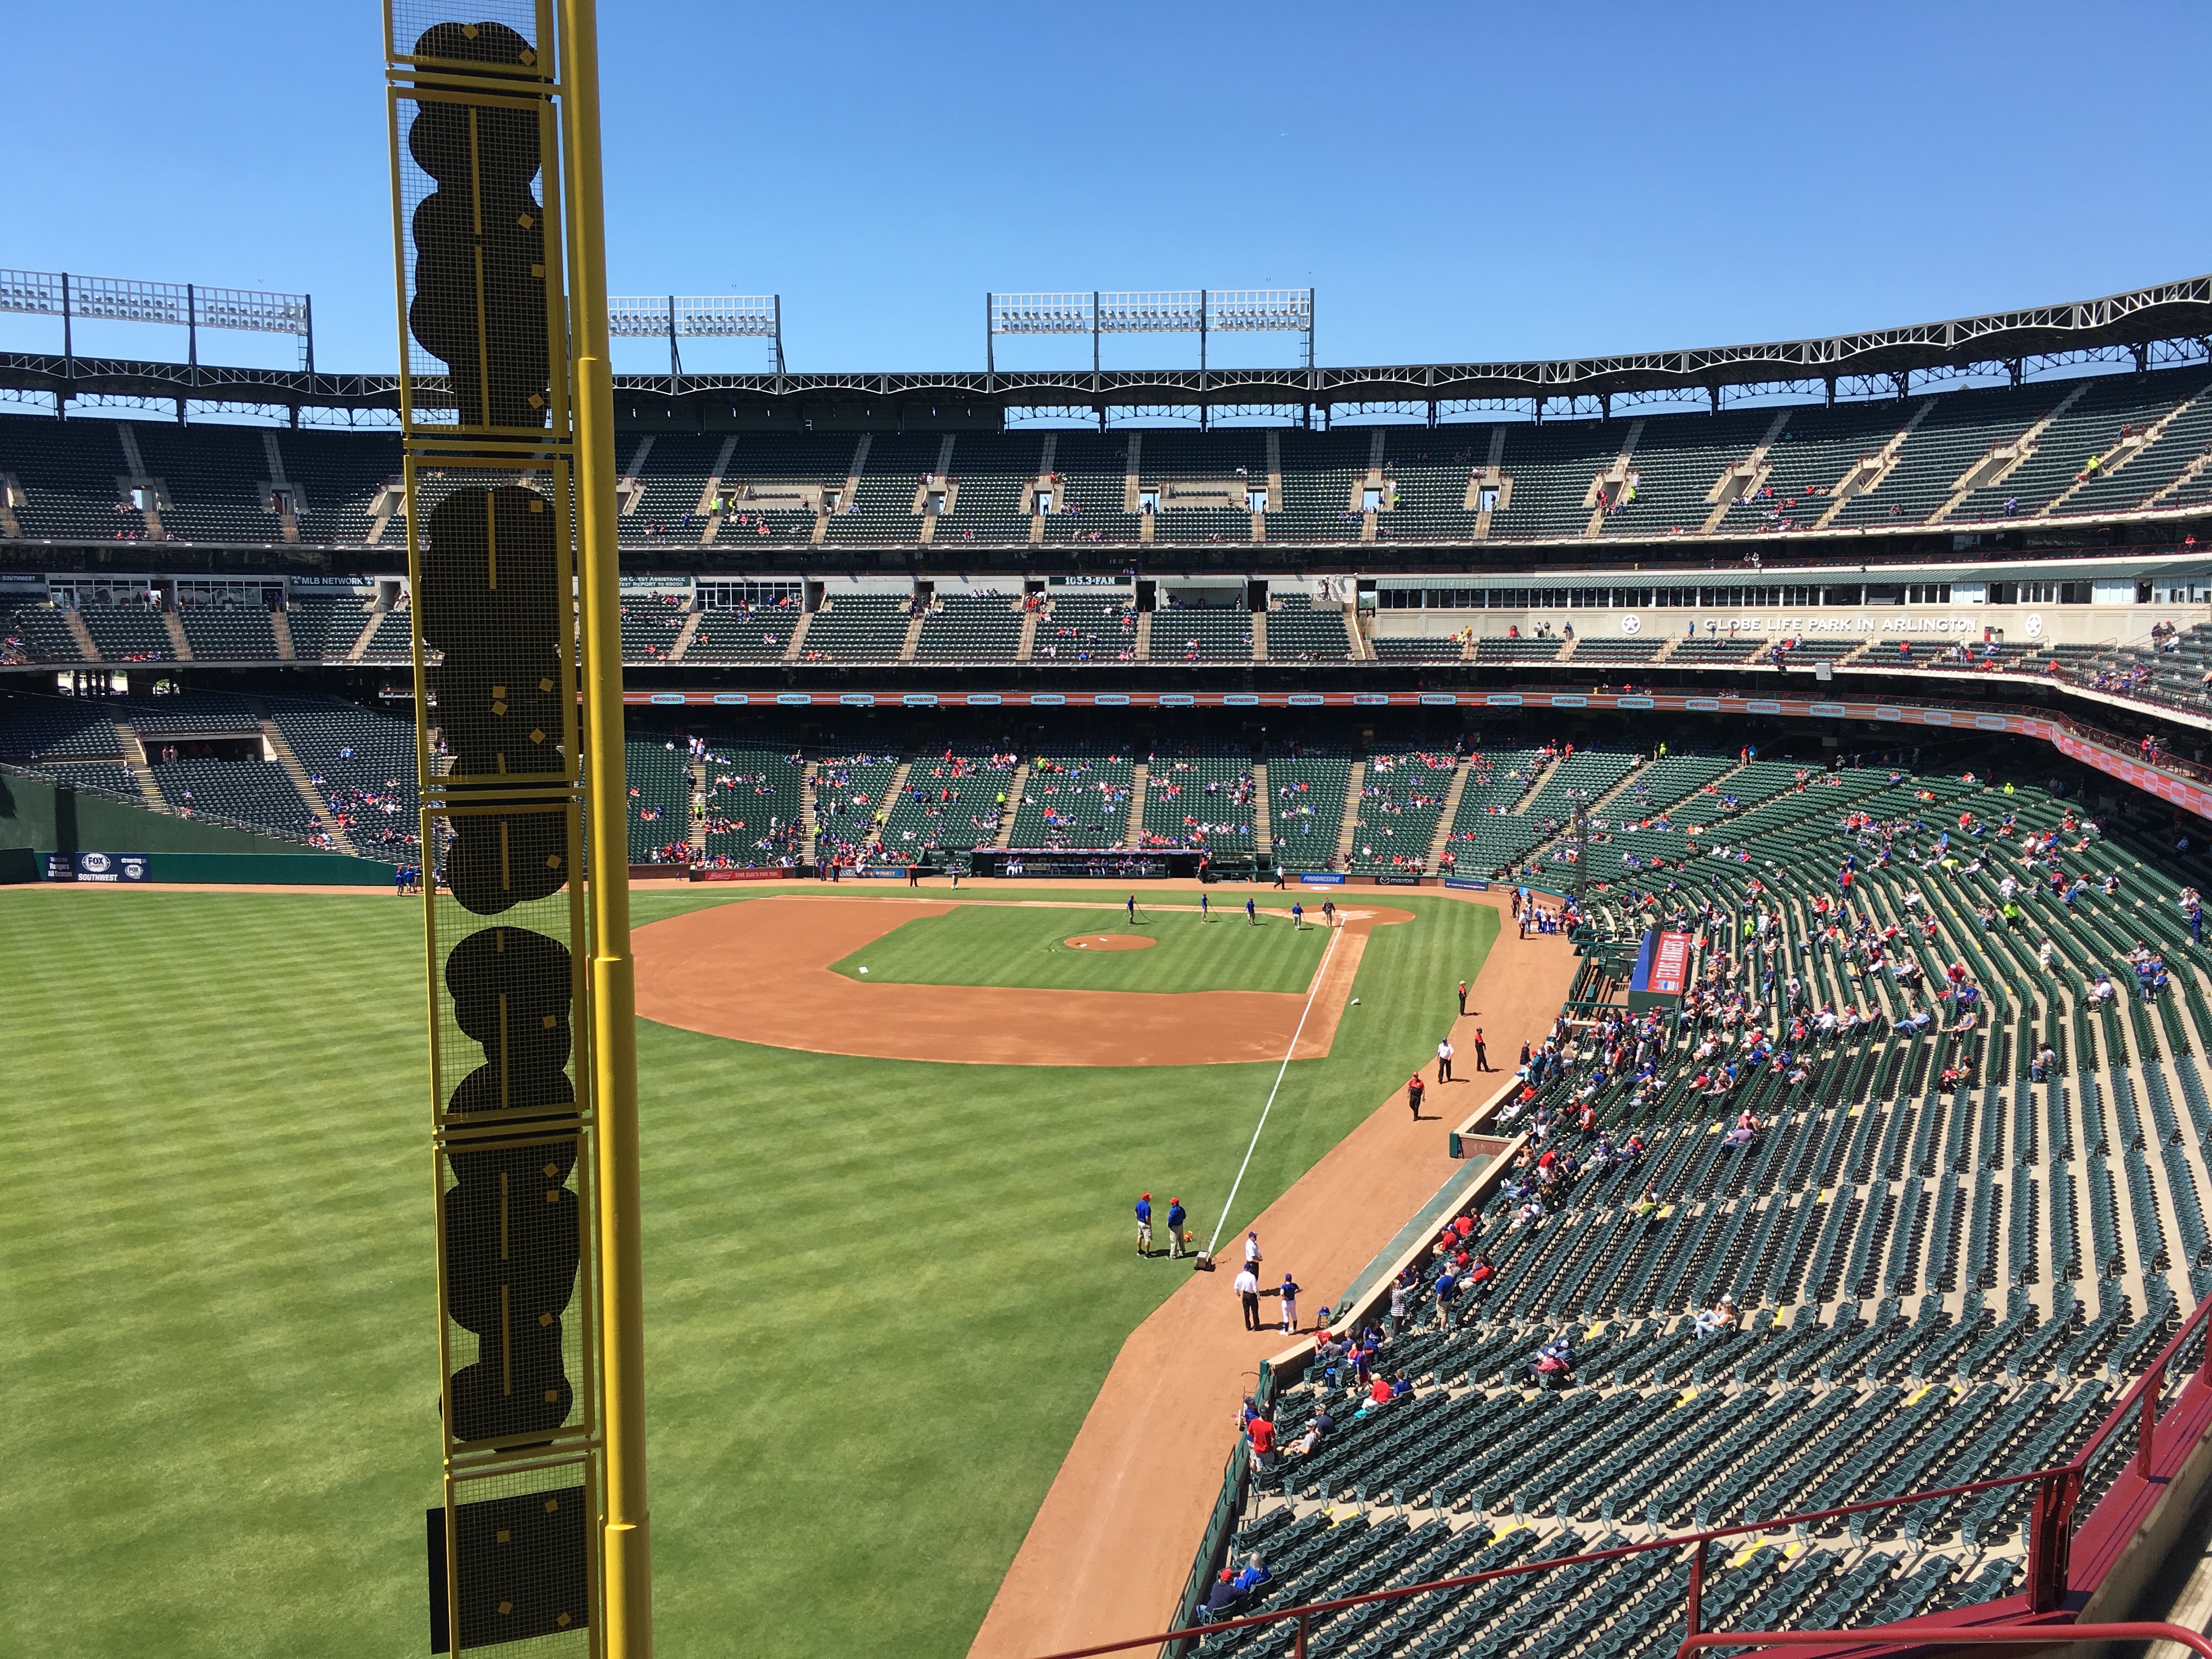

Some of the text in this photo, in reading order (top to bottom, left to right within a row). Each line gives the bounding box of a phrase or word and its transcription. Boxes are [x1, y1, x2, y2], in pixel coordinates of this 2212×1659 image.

[1065, 577, 1092, 585] 105.3
[1095, 577, 1115, 585] FAN
[1704, 618, 1977, 631] GLOBE LIFE PARK IN ARLINGTON
[88, 857, 104, 865] FOX
[78, 873, 119, 882] SOUTHWEST
[1656, 961, 1681, 979] TEXAS
